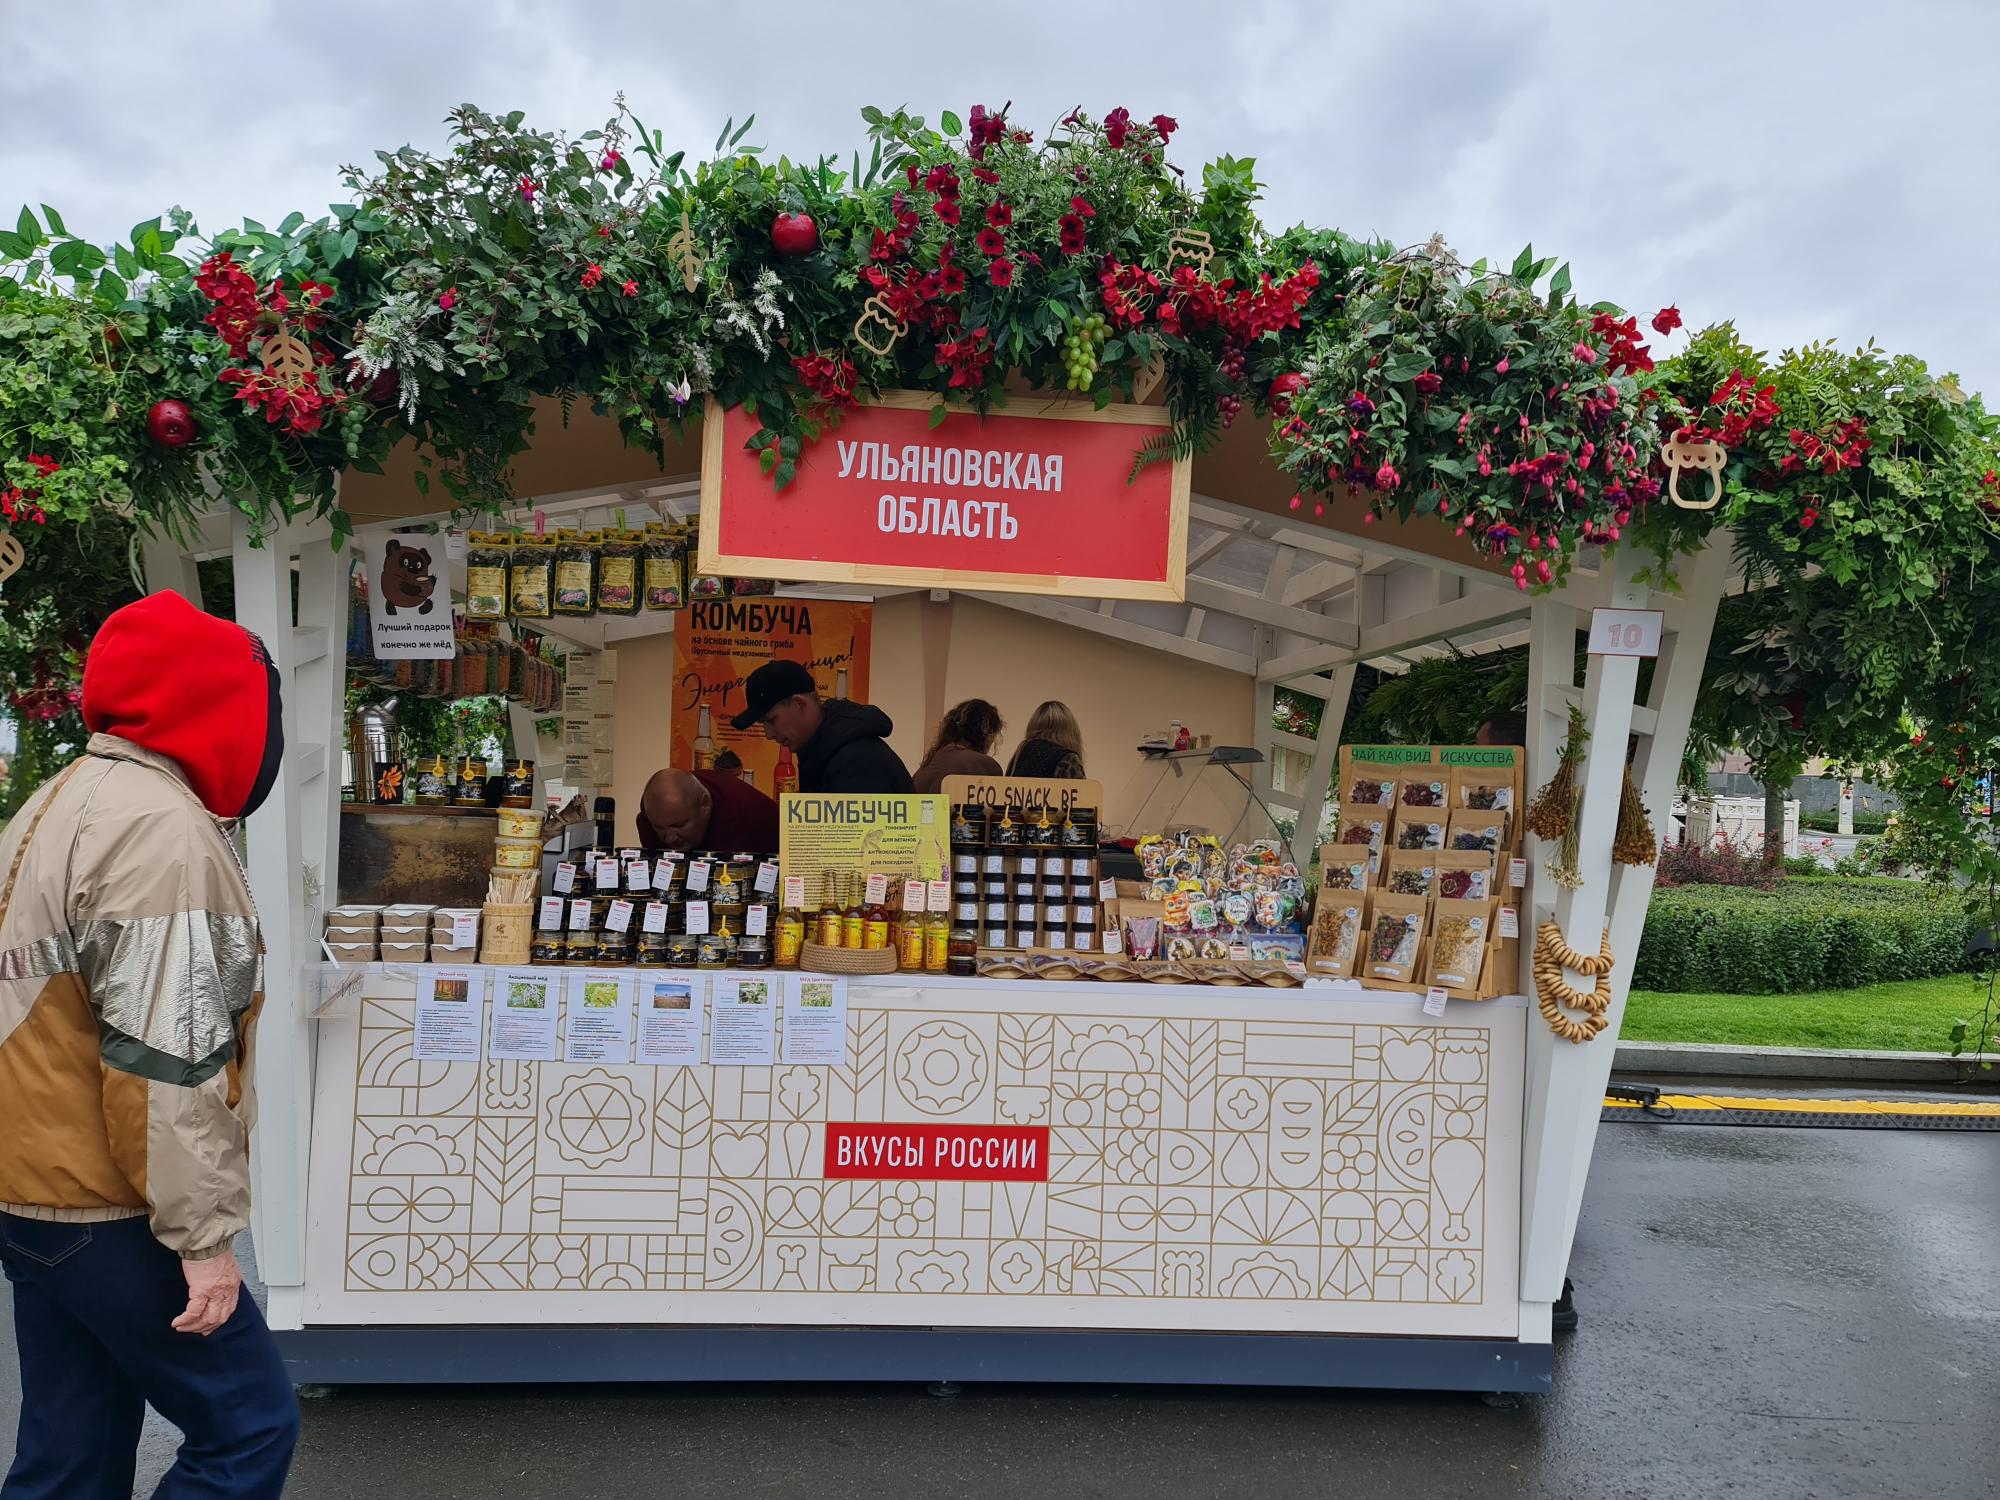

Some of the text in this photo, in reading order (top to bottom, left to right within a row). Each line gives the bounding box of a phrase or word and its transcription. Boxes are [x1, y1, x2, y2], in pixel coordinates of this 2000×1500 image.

[837, 440, 1063, 492] УЛЬЯНОВСКАЯ
[877, 494, 1018, 540] ОБЛАСТЬ
[378, 622, 451, 633] Лучший подарок
[690, 602, 812, 635] КОМБУЧА
[381, 641, 417, 649] конечно
[433, 639, 452, 649] мёд
[691, 637, 794, 649] на основе чайного гриба
[1608, 623, 1643, 649] 10
[682, 673, 747, 711] Энерг
[1352, 747, 1514, 764] ЧАЙ КАК ВИД ИСКУССТВА
[967, 784, 996, 808] ECO
[1004, 786, 1051, 808] SNACK
[788, 799, 907, 824] КОМБУЧА
[837, 1135, 1037, 1169] ВКУСЫ РОССИИ
